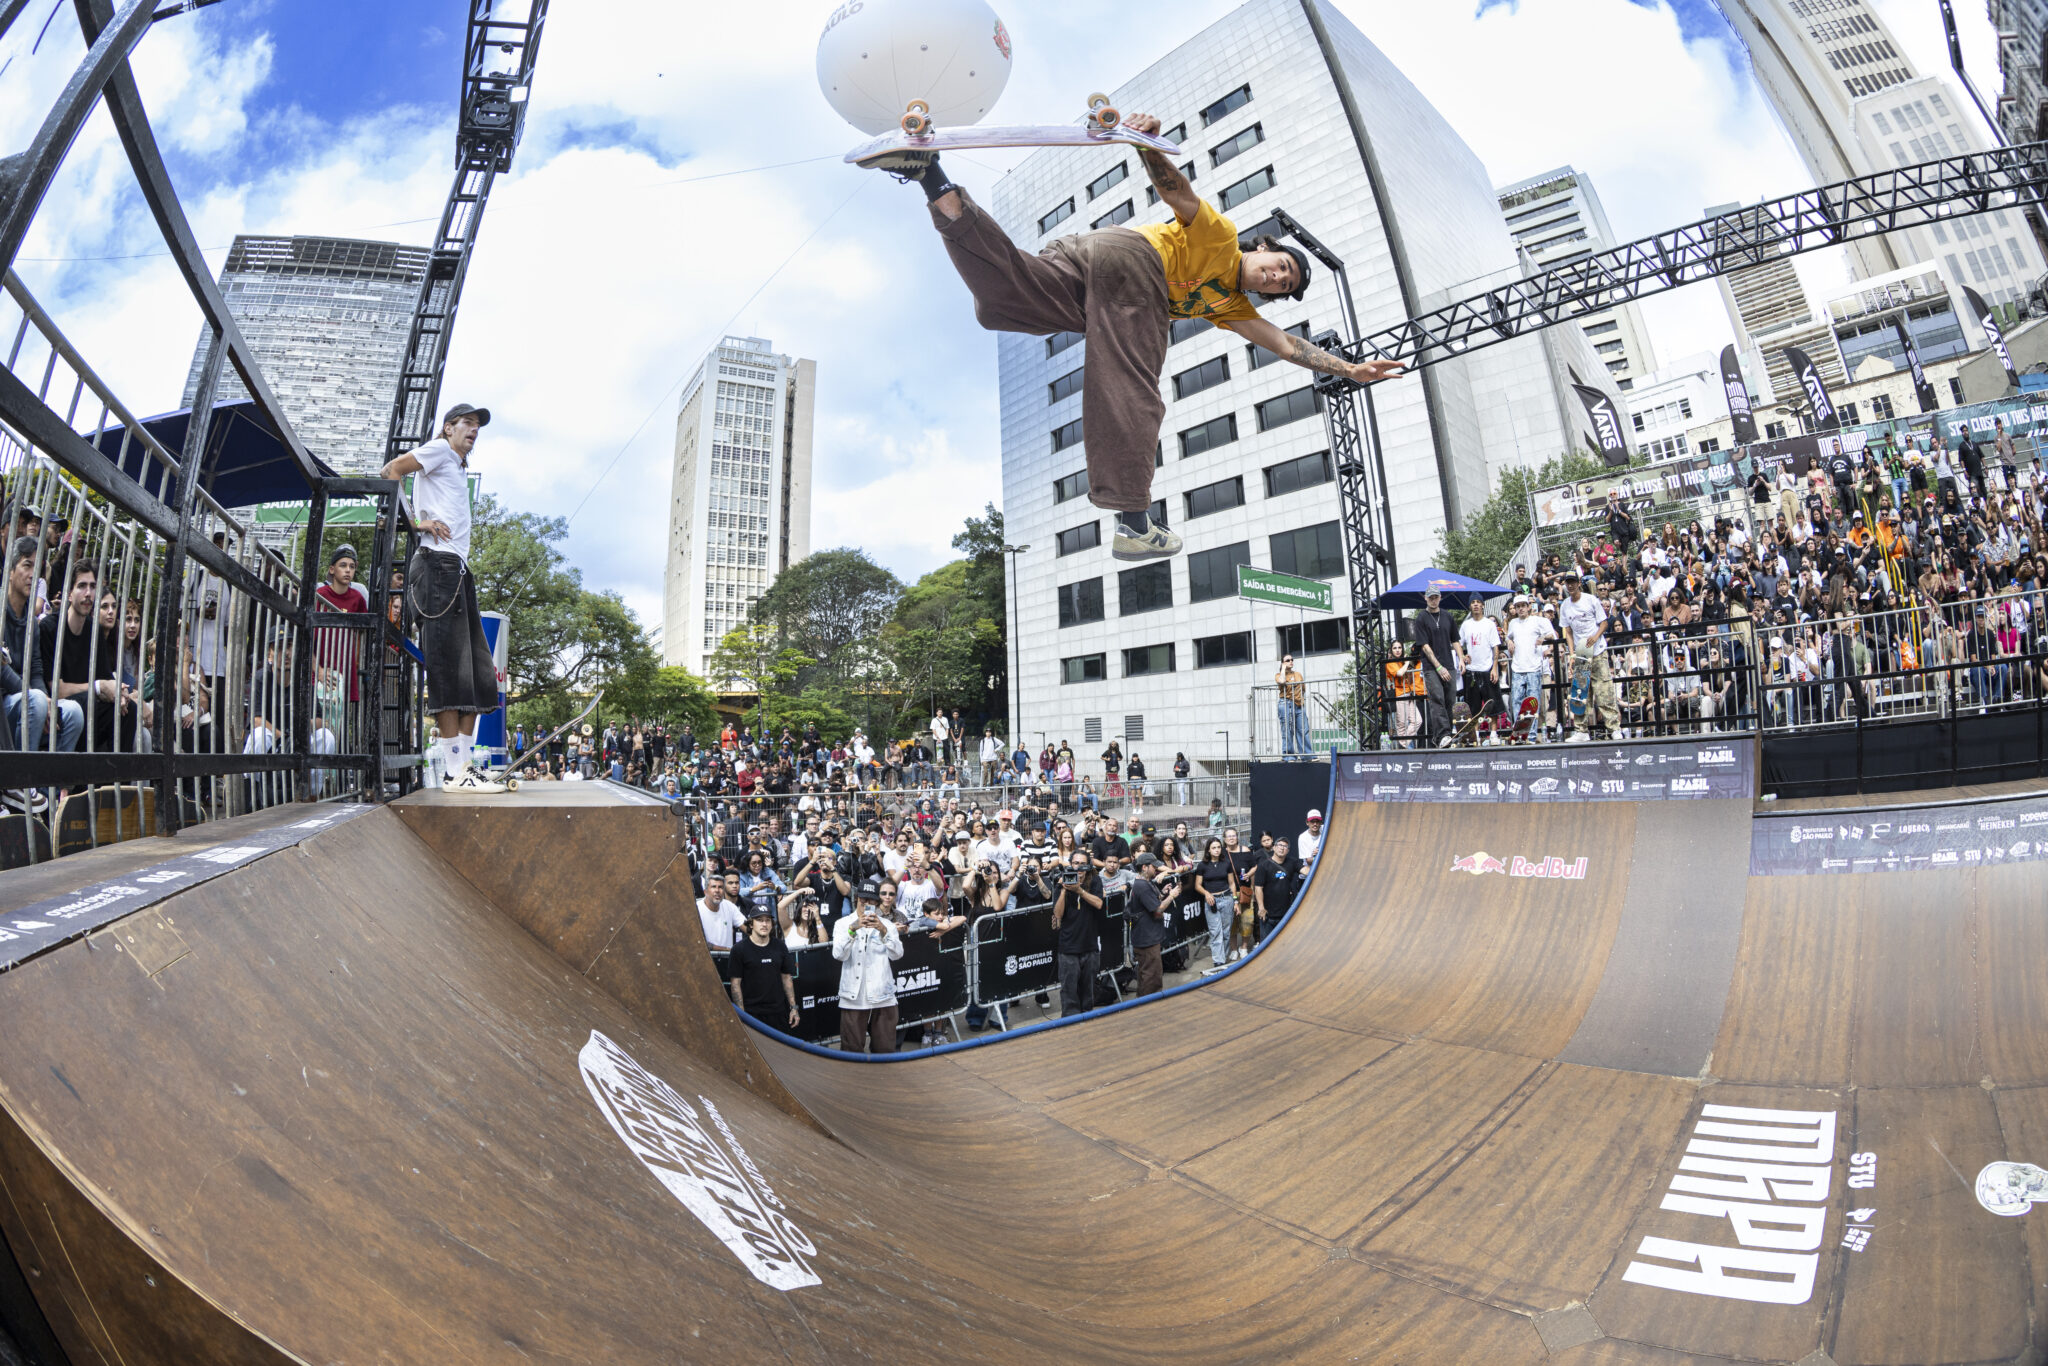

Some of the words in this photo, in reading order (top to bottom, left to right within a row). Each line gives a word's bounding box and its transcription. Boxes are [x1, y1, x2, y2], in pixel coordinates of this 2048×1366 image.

[1802, 364, 1832, 421] VANS
[1591, 398, 1622, 450] VANS
[1970, 415, 1996, 432] CLOSE
[2010, 408, 2030, 425] THIS
[2030, 404, 2048, 421] ARE
[1634, 478, 1664, 496] CLOSE
[1666, 475, 1680, 488] TO
[1682, 471, 1705, 486] THIS
[1708, 463, 1735, 480] AREA
[1243, 579, 1265, 590] SAÍDA
[1266, 584, 1276, 592] DE
[1277, 586, 1316, 600] EMERGÊNCIA
[1698, 750, 1736, 763] BRASIL
[1468, 783, 1490, 795] STU
[1602, 780, 1624, 793] STU
[1672, 778, 1710, 791] BRASIL
[2020, 812, 2048, 822] POPEYE
[1980, 820, 2015, 830] HEINEKEN
[1932, 852, 1958, 862] BRASIL
[1964, 850, 1981, 861] STU
[1184, 901, 1200, 920] STU
[1019, 952, 1045, 962] PREFEITURA
[1019, 961, 1032, 970] SÃO
[1032, 956, 1053, 966] PAULO
[896, 970, 941, 992] RASIL
[818, 996, 840, 1004] PETRO
[698, 1094, 785, 1210] SKATEBOARDING
[1848, 1152, 1877, 1189] STU
